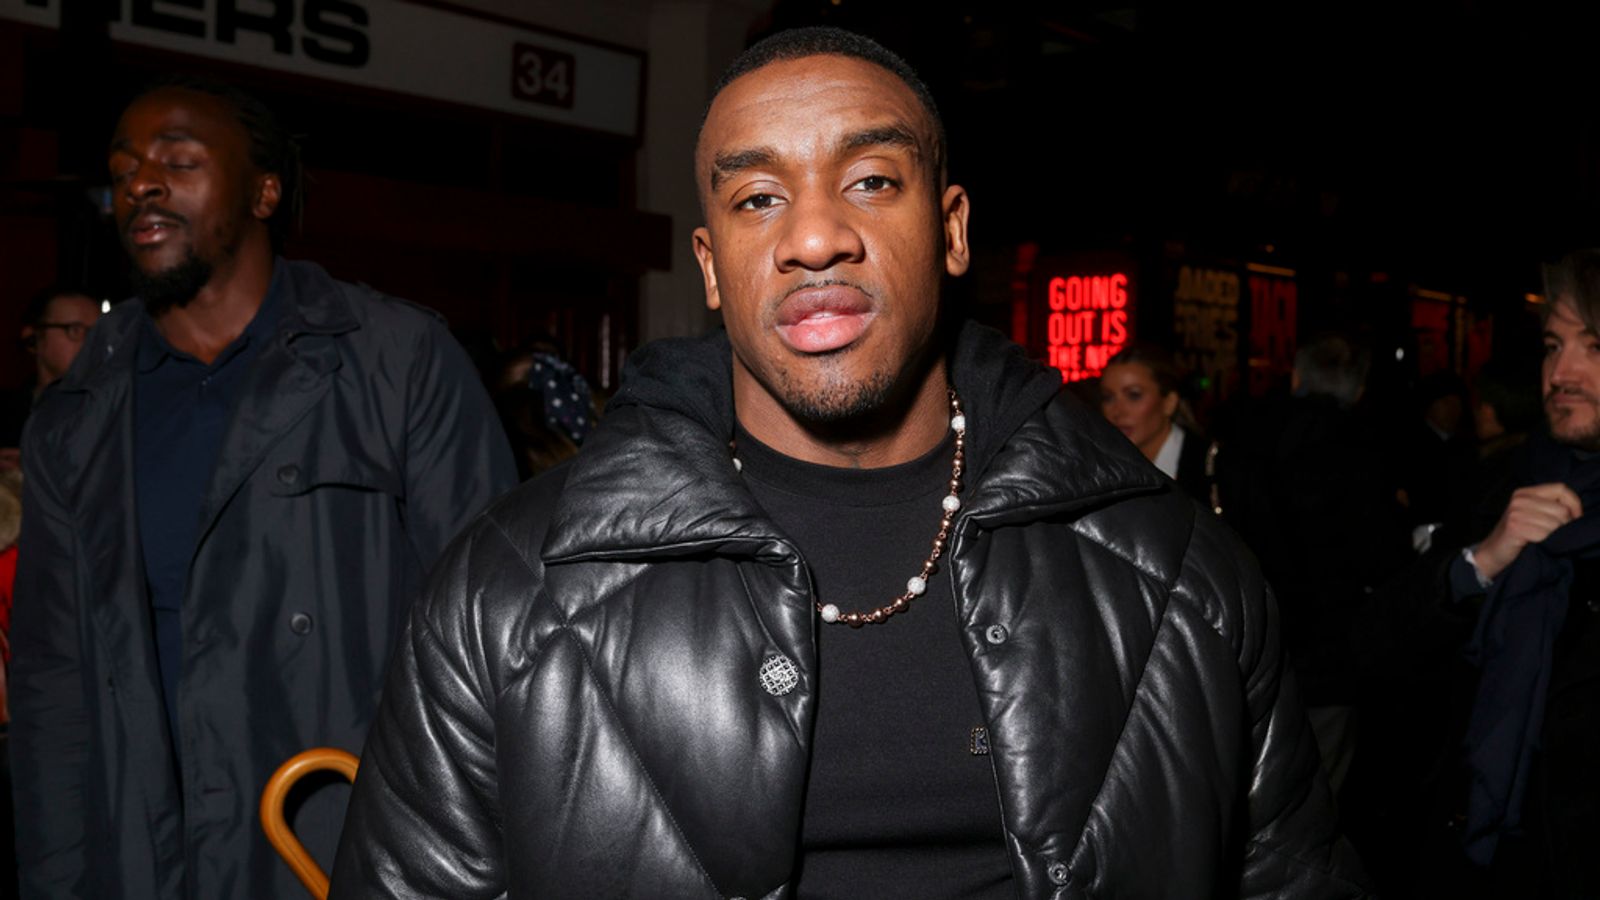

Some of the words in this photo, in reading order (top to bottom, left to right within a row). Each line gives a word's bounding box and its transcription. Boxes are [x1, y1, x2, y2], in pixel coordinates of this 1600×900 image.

[518, 51, 569, 100] 34
[1049, 272, 1128, 311] GOING
[1048, 310, 1094, 345] OUT
[1102, 309, 1128, 344] IS
[1048, 344, 1081, 370] THE
[1085, 343, 1123, 371] NE
